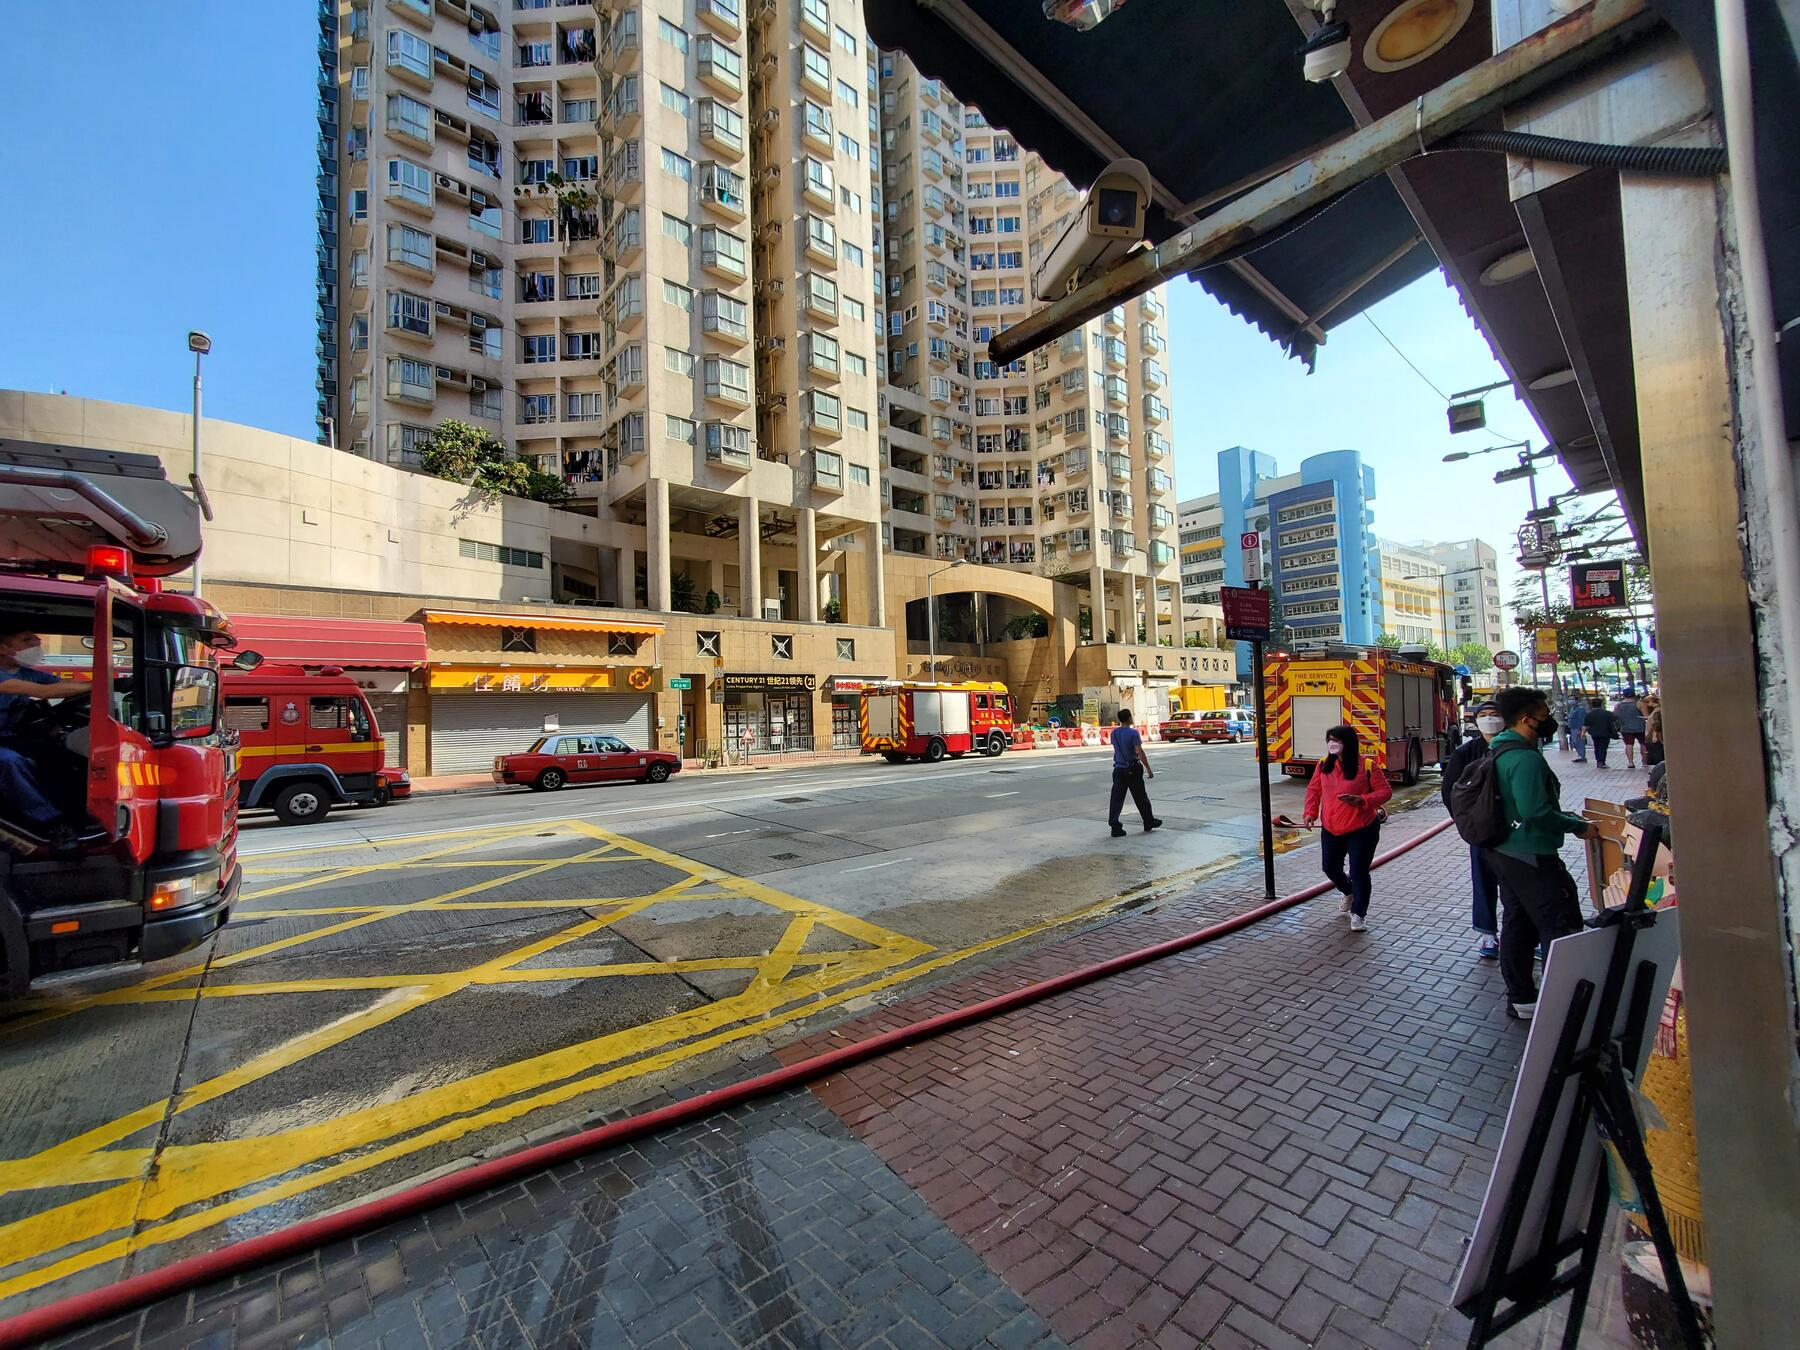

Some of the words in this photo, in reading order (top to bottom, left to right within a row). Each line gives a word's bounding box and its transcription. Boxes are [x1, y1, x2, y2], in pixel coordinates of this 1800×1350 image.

[1576, 596, 1617, 607] select
[726, 676, 757, 684] CENTURY
[759, 676, 766, 684] 21
